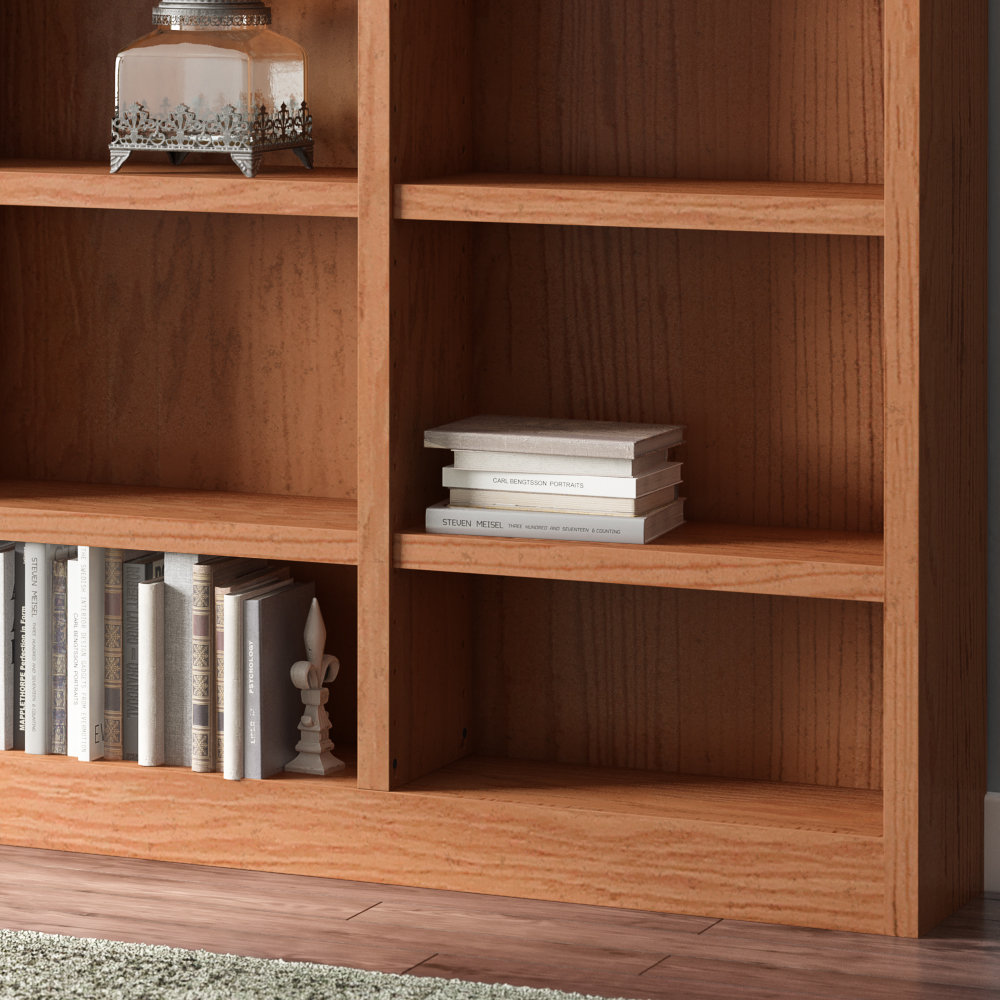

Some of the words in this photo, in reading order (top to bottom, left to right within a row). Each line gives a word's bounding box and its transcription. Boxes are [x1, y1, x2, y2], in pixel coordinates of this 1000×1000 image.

[509, 478, 547, 487] BENGTSSON
[549, 480, 584, 489] PORTRAITS
[442, 518, 472, 528] STEVEN
[476, 520, 504, 529] MEISEL
